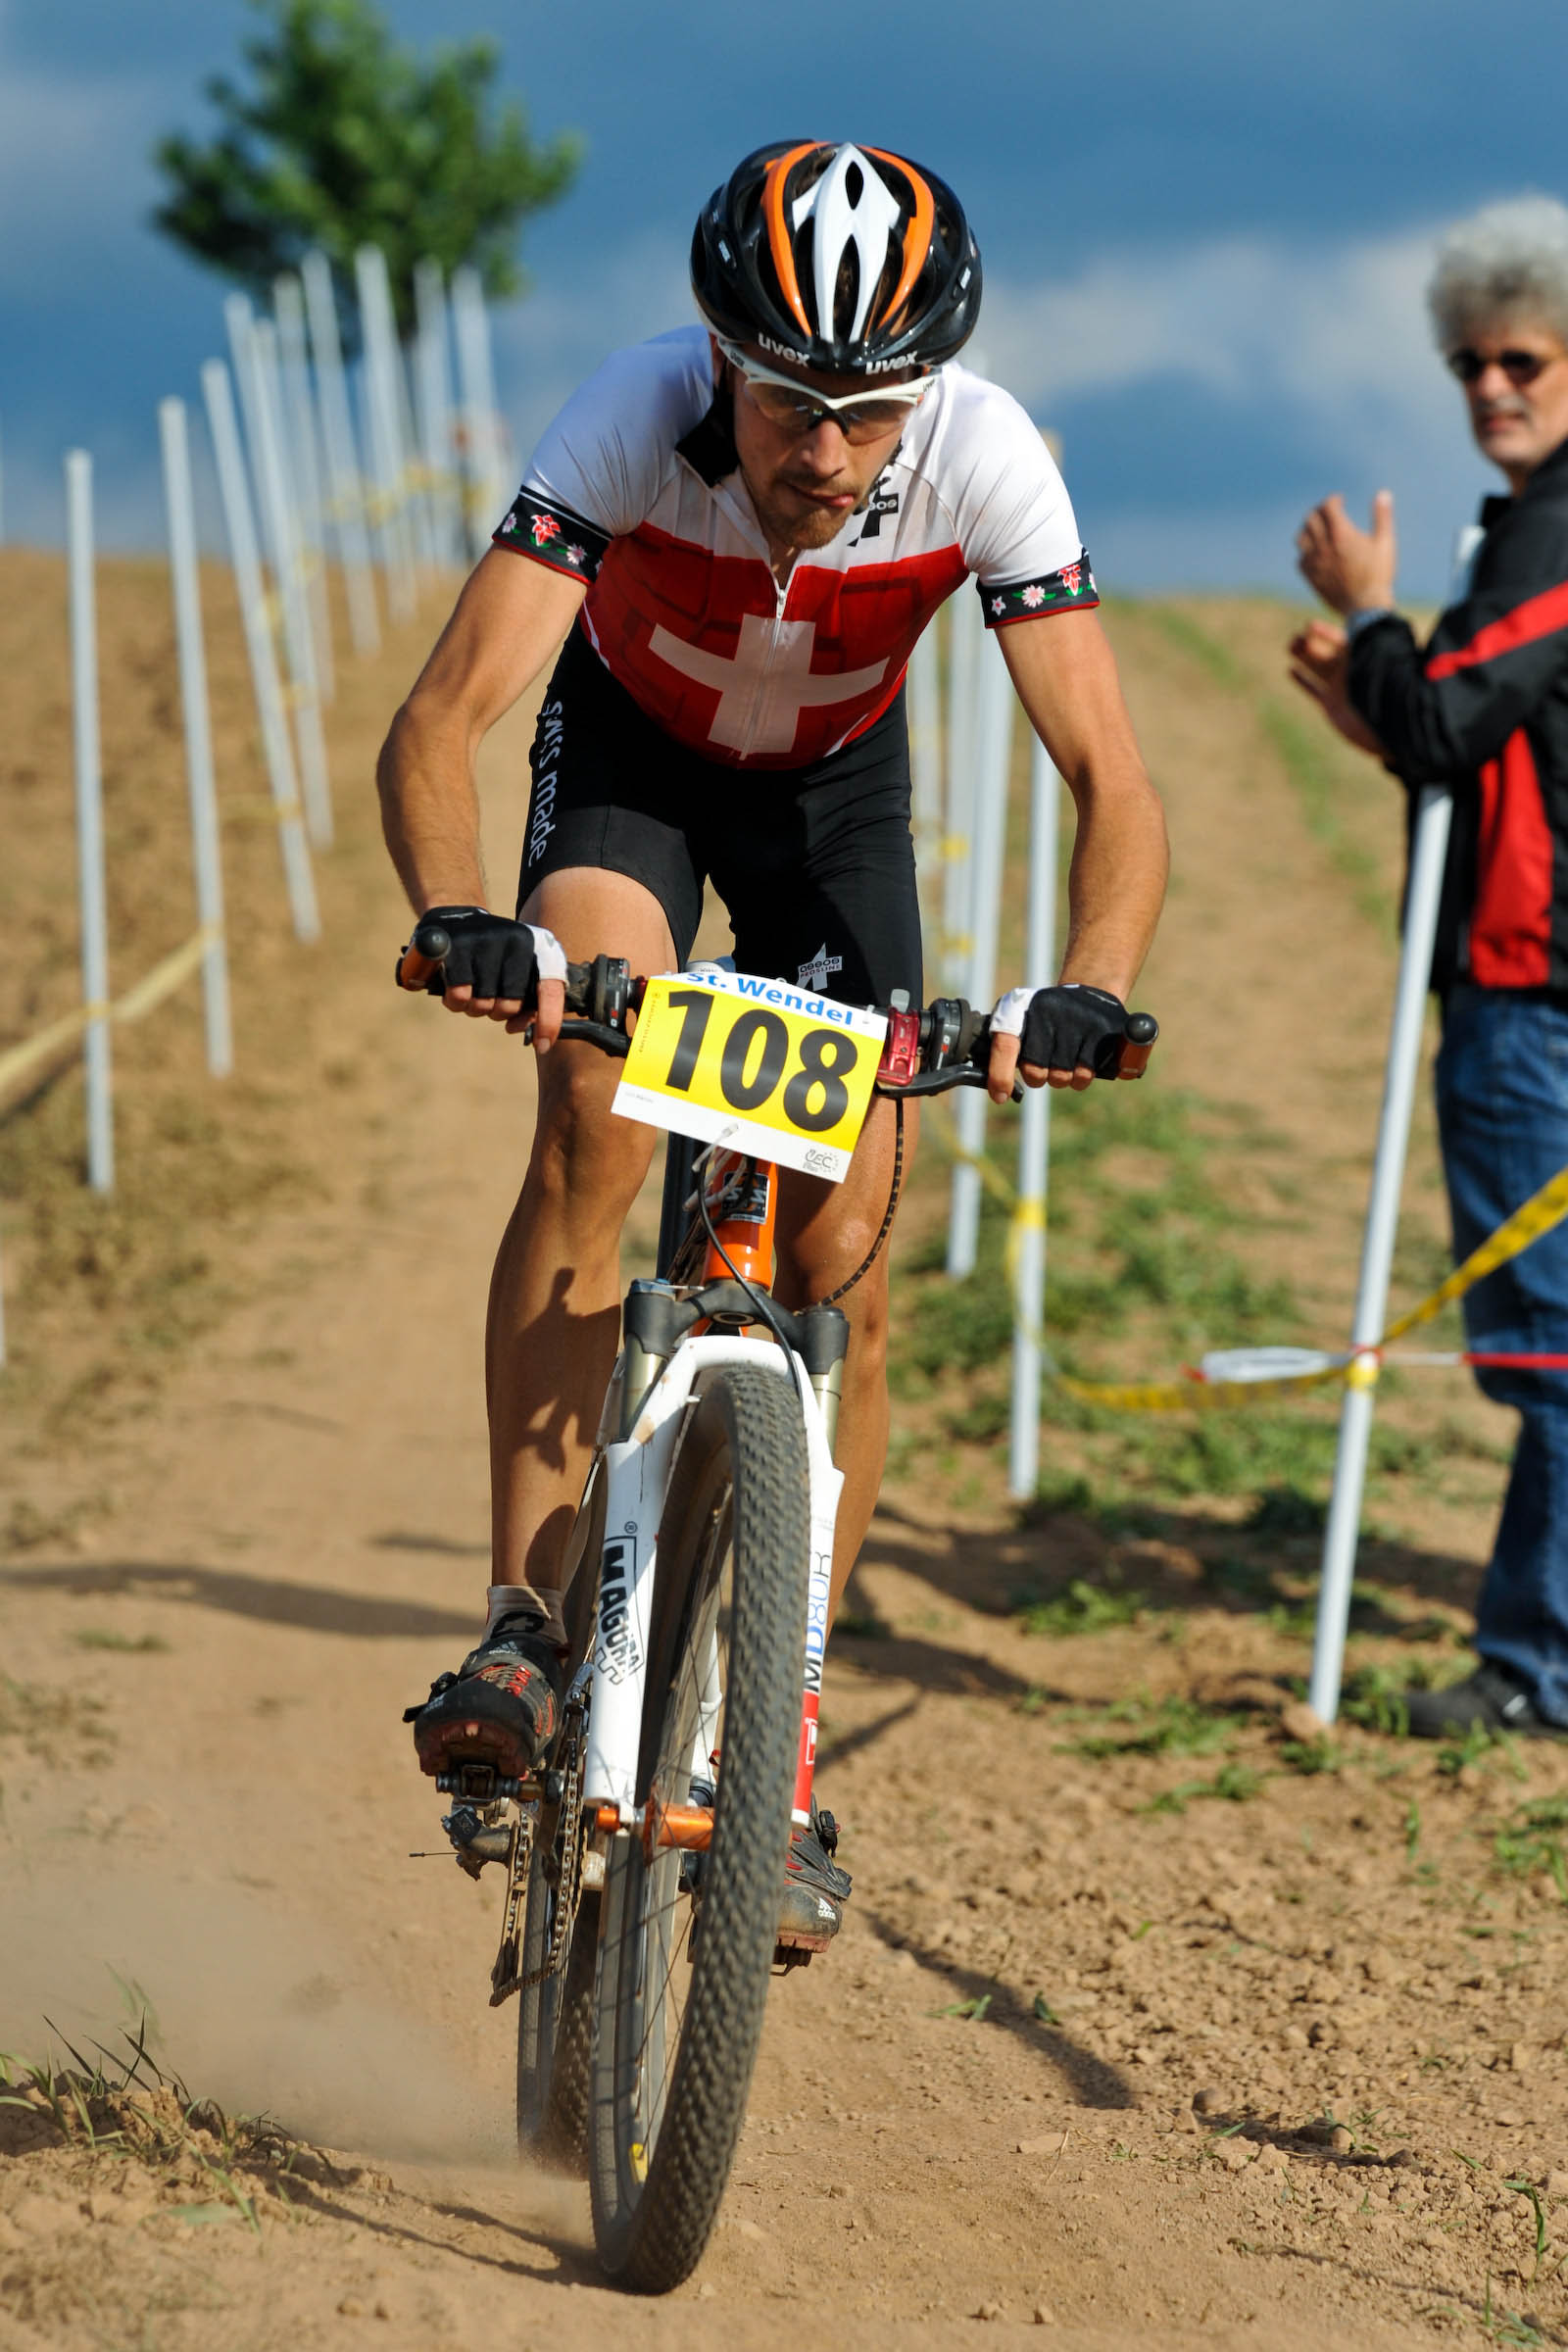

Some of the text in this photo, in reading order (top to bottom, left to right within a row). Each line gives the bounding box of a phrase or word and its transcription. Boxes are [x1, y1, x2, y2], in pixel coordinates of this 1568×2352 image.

[758, 332, 811, 368] uvex
[864, 350, 918, 376] uvex
[527, 769, 558, 868] made
[736, 977, 855, 1026] Wendel
[664, 989, 858, 1133] 108
